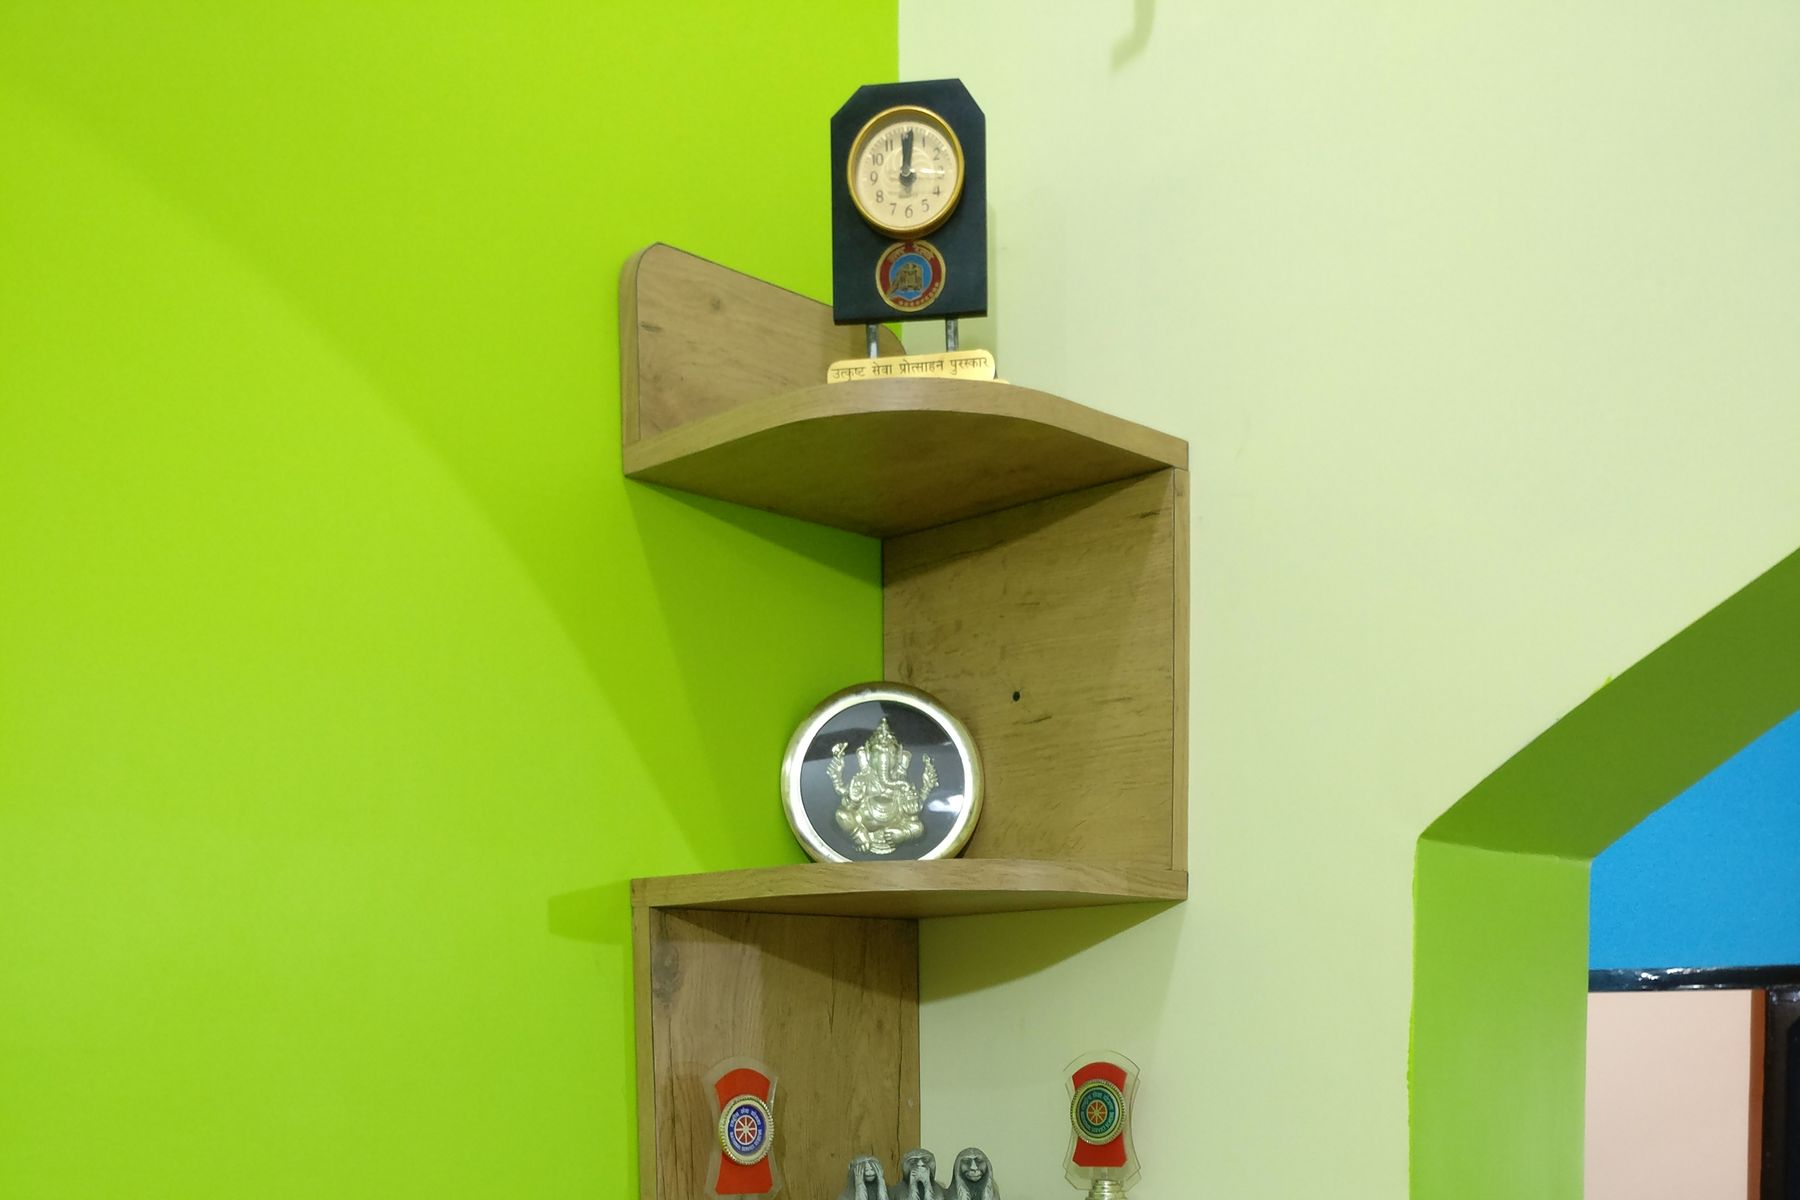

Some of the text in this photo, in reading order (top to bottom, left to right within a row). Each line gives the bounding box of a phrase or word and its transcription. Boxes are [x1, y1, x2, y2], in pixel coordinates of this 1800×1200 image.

[885, 139, 894, 152] 11
[872, 153, 884, 166] 10
[933, 147, 941, 160] 2
[870, 171, 878, 185] 9
[876, 190, 884, 203] 8
[932, 186, 941, 197] 4
[889, 203, 897, 216] 7
[905, 204, 913, 218] 6
[921, 199, 930, 212] 5
[872, 361, 893, 375] सेवा
[899, 358, 944, 375] प्रोत्साहन
[950, 357, 989, 375] पुरस्कार
